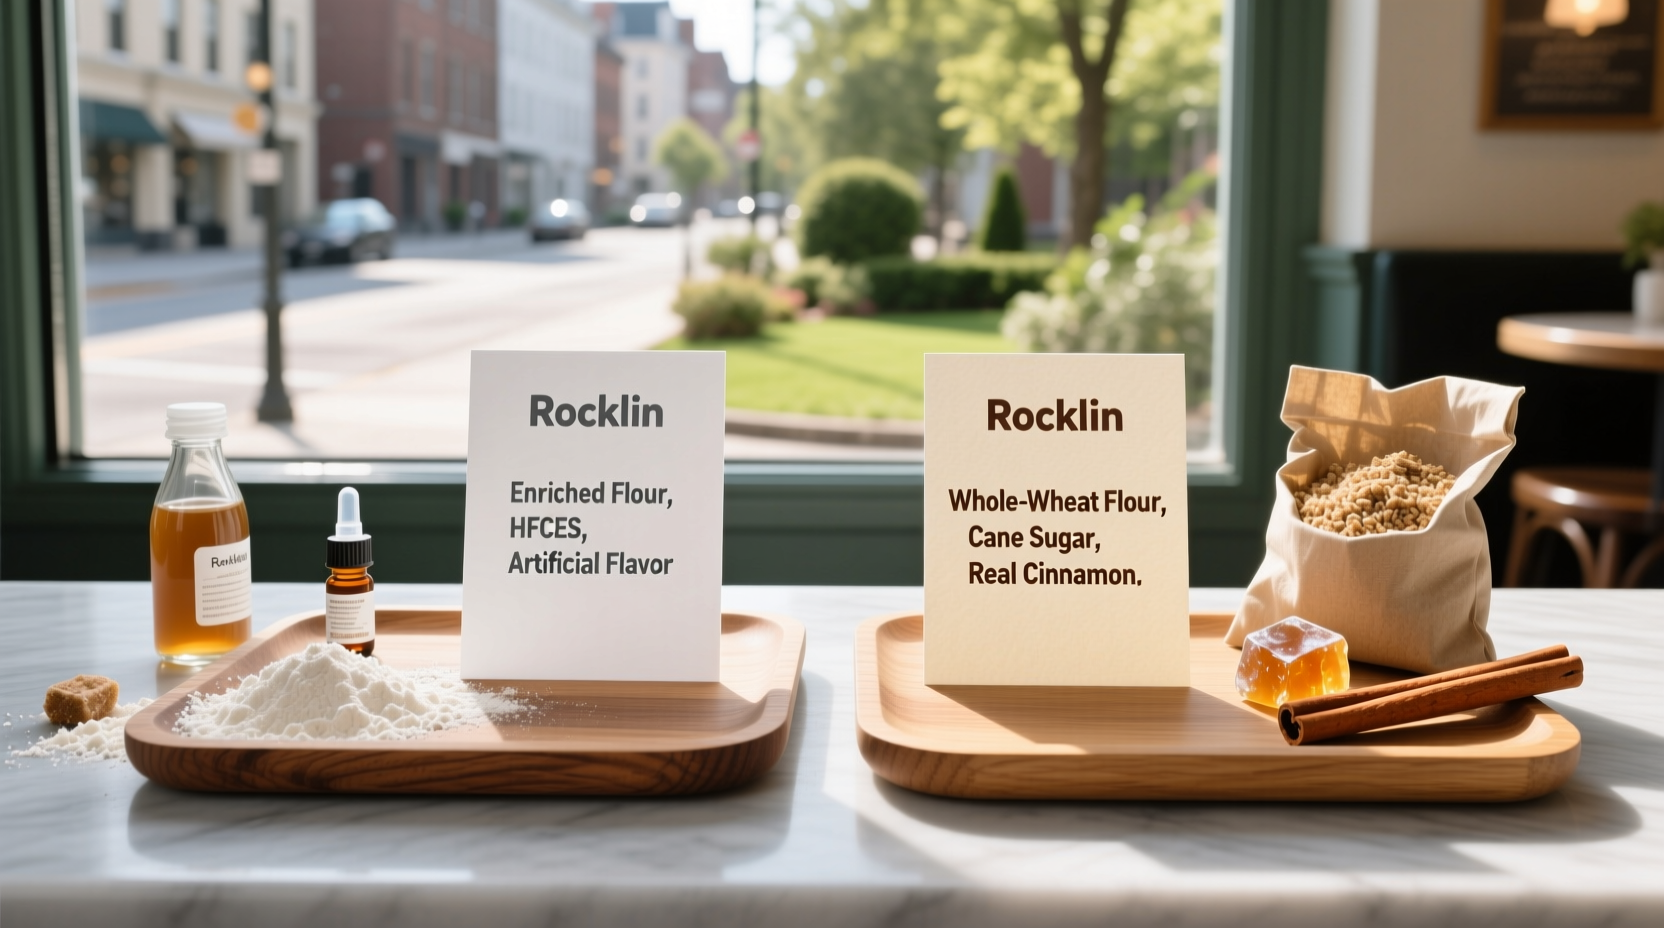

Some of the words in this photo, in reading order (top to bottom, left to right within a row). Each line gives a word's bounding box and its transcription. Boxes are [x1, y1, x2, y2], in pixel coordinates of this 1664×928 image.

[530, 394, 663, 427] Rocklin
[988, 398, 1123, 431] Rocklin
[511, 481, 604, 503] Enriched
[612, 481, 673, 509] Flour,
[949, 489, 1099, 512] Whole-Wheat
[1105, 490, 1167, 517] Flour,
[510, 517, 588, 544] HFCES,
[969, 525, 1024, 548] Cane
[1030, 525, 1101, 554] Sugar,
[508, 551, 599, 574] Artificial
[606, 552, 673, 574] Flavor
[969, 562, 1016, 584] Real
